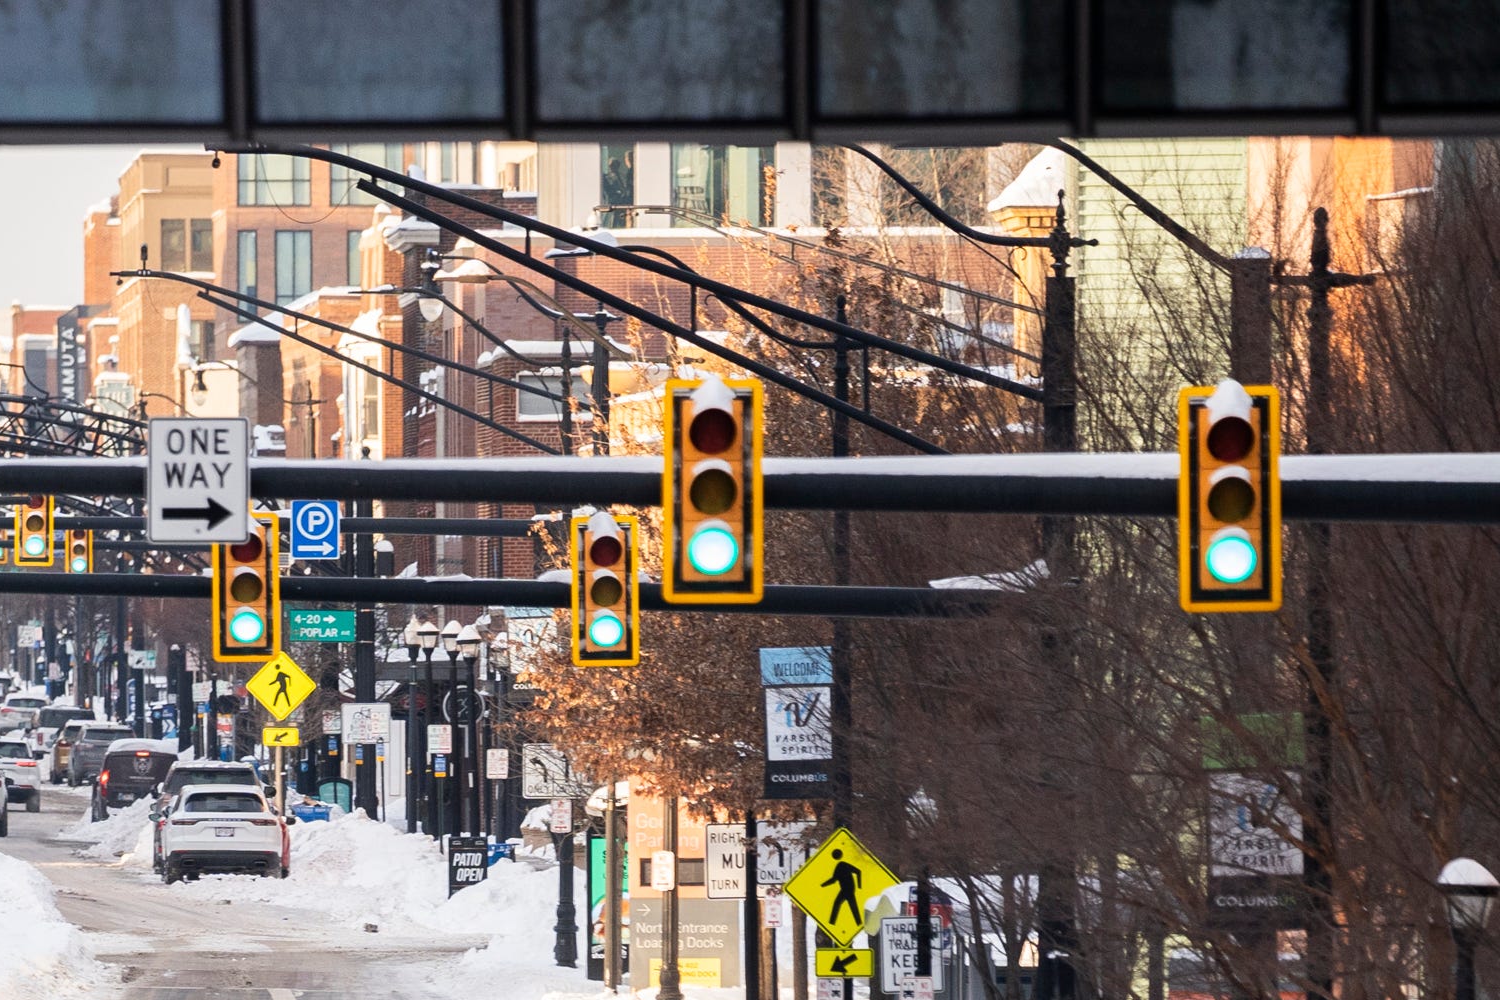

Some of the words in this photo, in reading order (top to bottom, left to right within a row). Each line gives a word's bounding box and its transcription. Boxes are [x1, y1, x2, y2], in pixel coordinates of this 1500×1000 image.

[167, 428, 230, 455] ONE
[164, 462, 232, 489] WAY
[308, 511, 326, 532] P
[294, 614, 320, 624] 4-20
[300, 628, 338, 637] POPLAR
[773, 662, 821, 677] WELCOME
[771, 773, 828, 783] COLUMBUS
[636, 834, 700, 851] Parng
[710, 832, 742, 844] RIGHT
[452, 852, 482, 867] PATIO
[722, 853, 745, 869] MU
[455, 867, 484, 882] OPEN
[760, 871, 788, 881] ONLY
[711, 880, 739, 890] TURN
[636, 923, 664, 934] Nort
[885, 923, 940, 934] THROH
[687, 936, 725, 949] Docks
[891, 954, 919, 968] KEE
